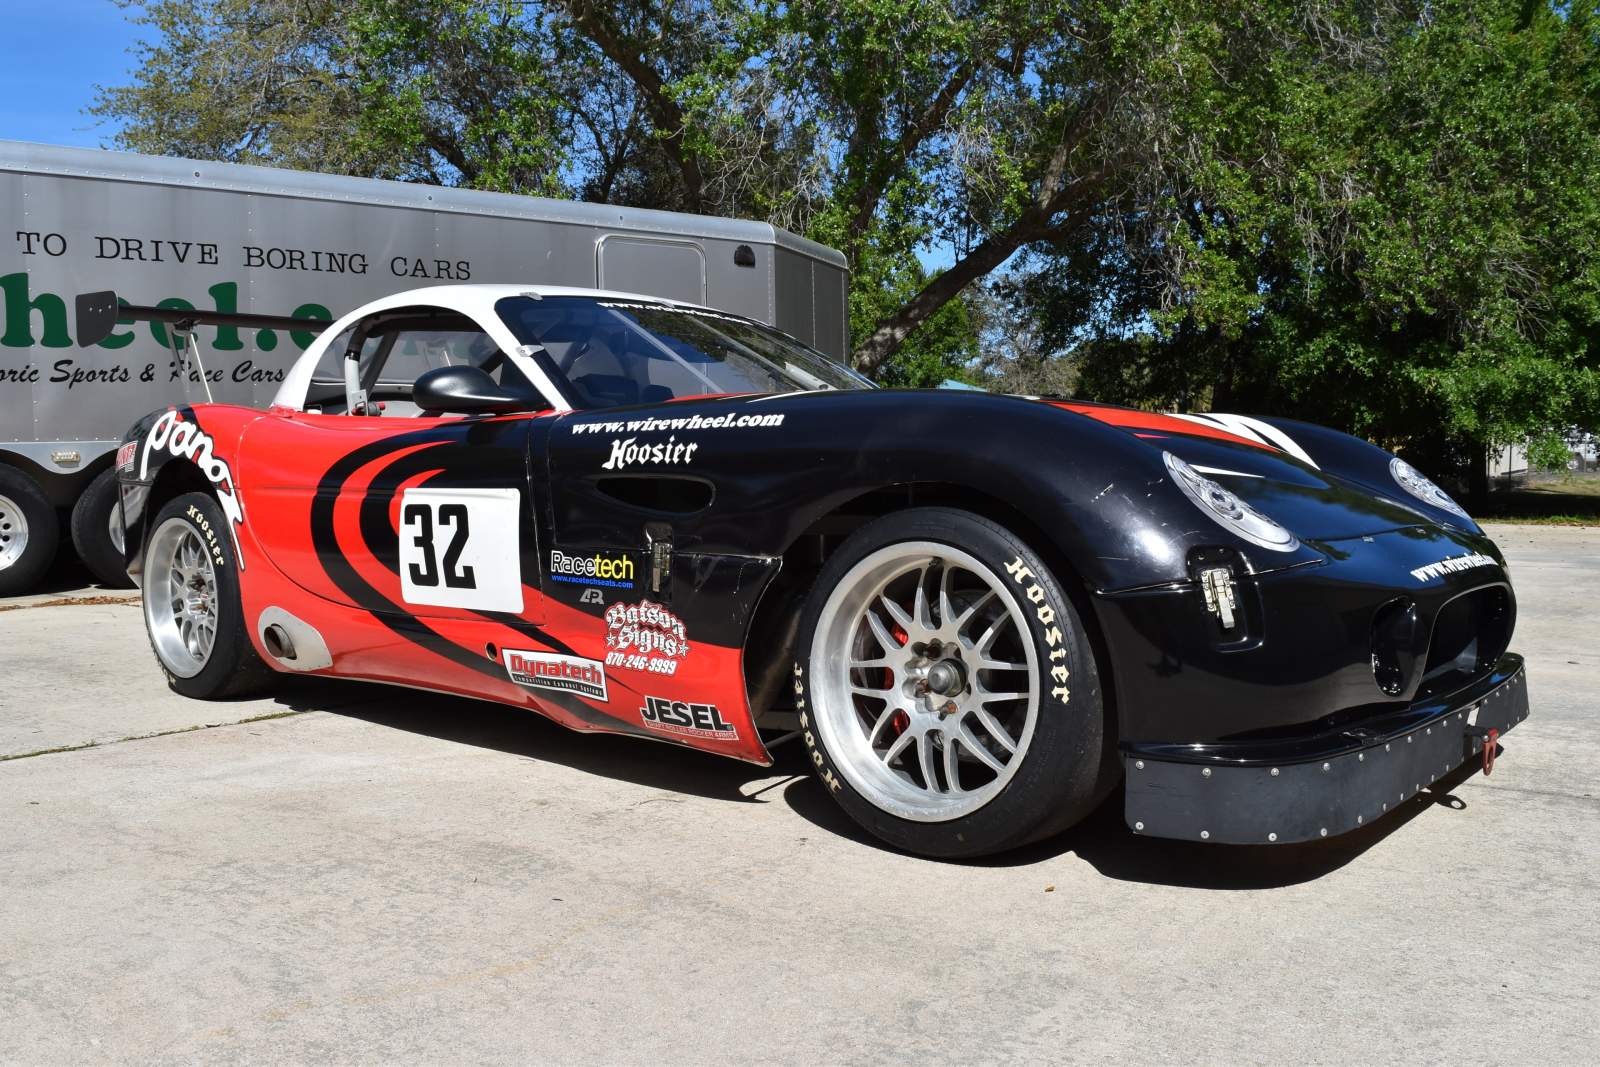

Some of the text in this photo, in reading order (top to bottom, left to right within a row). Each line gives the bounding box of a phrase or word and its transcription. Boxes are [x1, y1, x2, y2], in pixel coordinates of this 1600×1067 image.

[16, 231, 471, 281] TO DRIVE BORING CARS
[49, 359, 131, 390] Sports
[139, 363, 155, 382] &
[231, 360, 286, 383] Cars
[571, 412, 785, 435] www.wirewheel.com
[601, 434, 698, 470] Hoosier
[186, 504, 224, 567] Hoosier
[404, 503, 477, 590] 32
[551, 550, 634, 579] Racetech
[551, 575, 633, 588] www.racetechseats.com
[606, 599, 687, 641] Batson
[1003, 556, 1070, 704] Hoosier
[613, 623, 678, 657] Signs
[510, 654, 603, 686] Dynatech
[641, 696, 735, 732] JESEL
